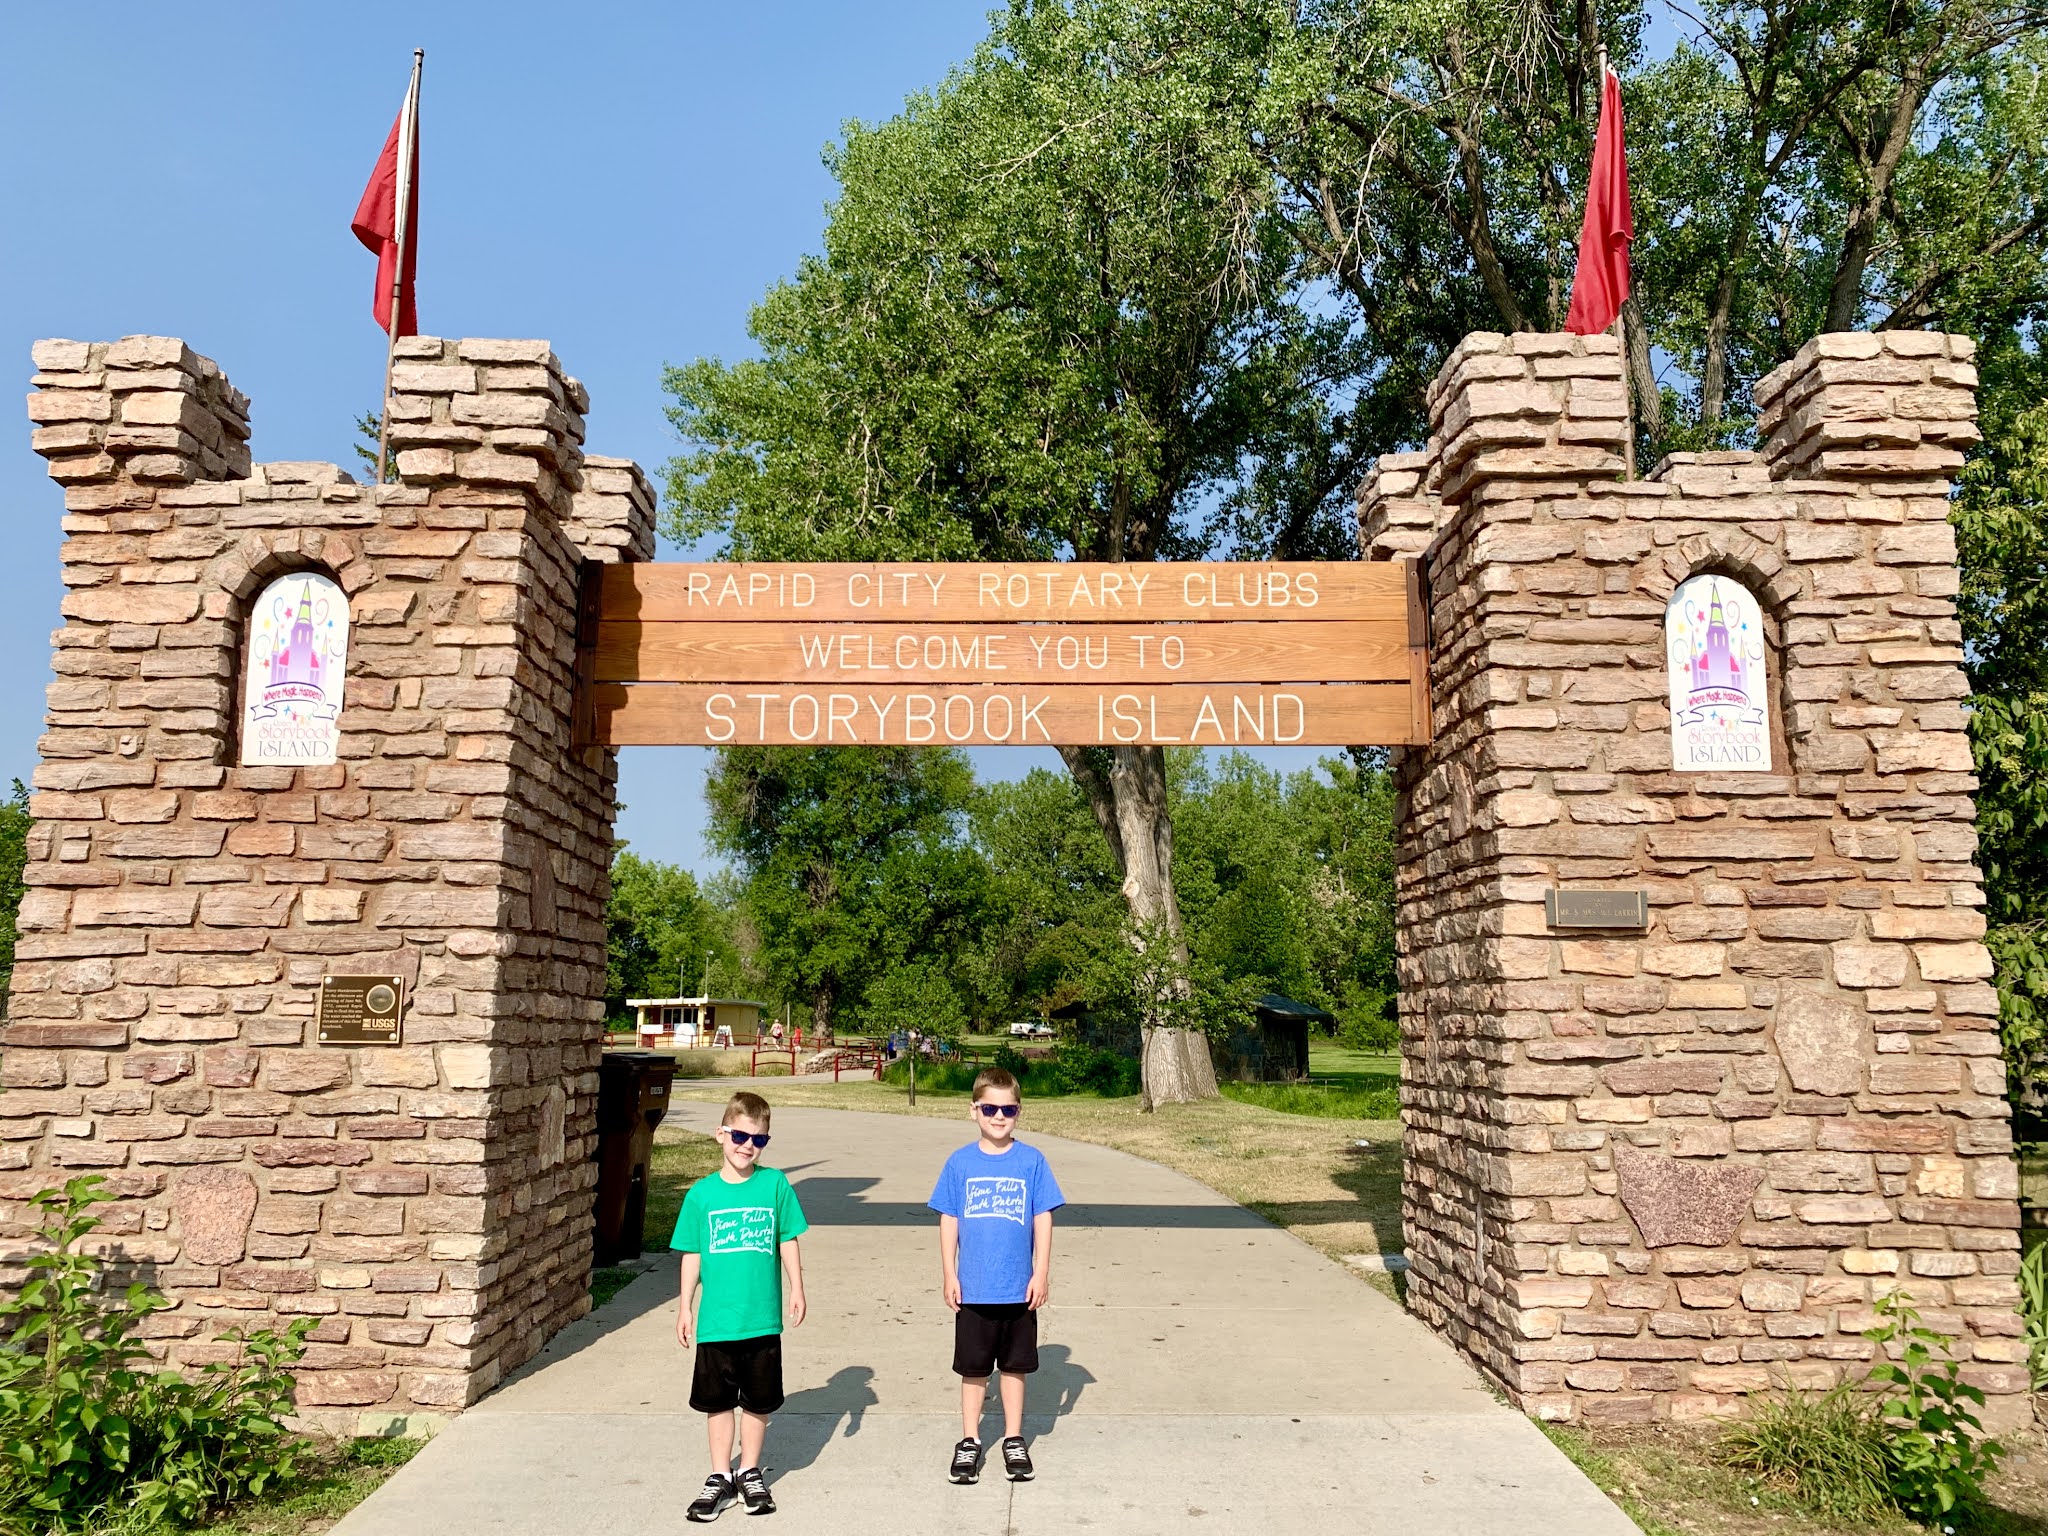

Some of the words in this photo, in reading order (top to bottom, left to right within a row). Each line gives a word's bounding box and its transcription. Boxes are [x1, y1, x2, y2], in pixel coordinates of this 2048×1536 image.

[687, 572, 816, 608] RAPID
[848, 572, 946, 608] CITY
[978, 572, 1150, 608] ROTARY
[1183, 571, 1319, 608] CLUBS
[799, 634, 1007, 670] WELCOME
[1028, 635, 1108, 670] YOU
[1130, 635, 1185, 670] TO
[704, 693, 1051, 742] STORYBOOK
[1098, 693, 1305, 743] ISLAND
[258, 722, 331, 744] Storybook
[1688, 727, 1761, 748] Storybook
[258, 740, 329, 758] ISLAND
[1689, 746, 1761, 762] ISLAND
[371, 1018, 396, 1028] USGS
[969, 1184, 993, 1200] Sioux
[995, 1180, 1019, 1193] Falls
[966, 1197, 990, 1216] South
[991, 1194, 1023, 1208] Dakota
[713, 1217, 738, 1234] Sioux
[742, 1210, 767, 1225] Falls
[711, 1230, 738, 1250] South
[739, 1224, 772, 1242] Dakota
